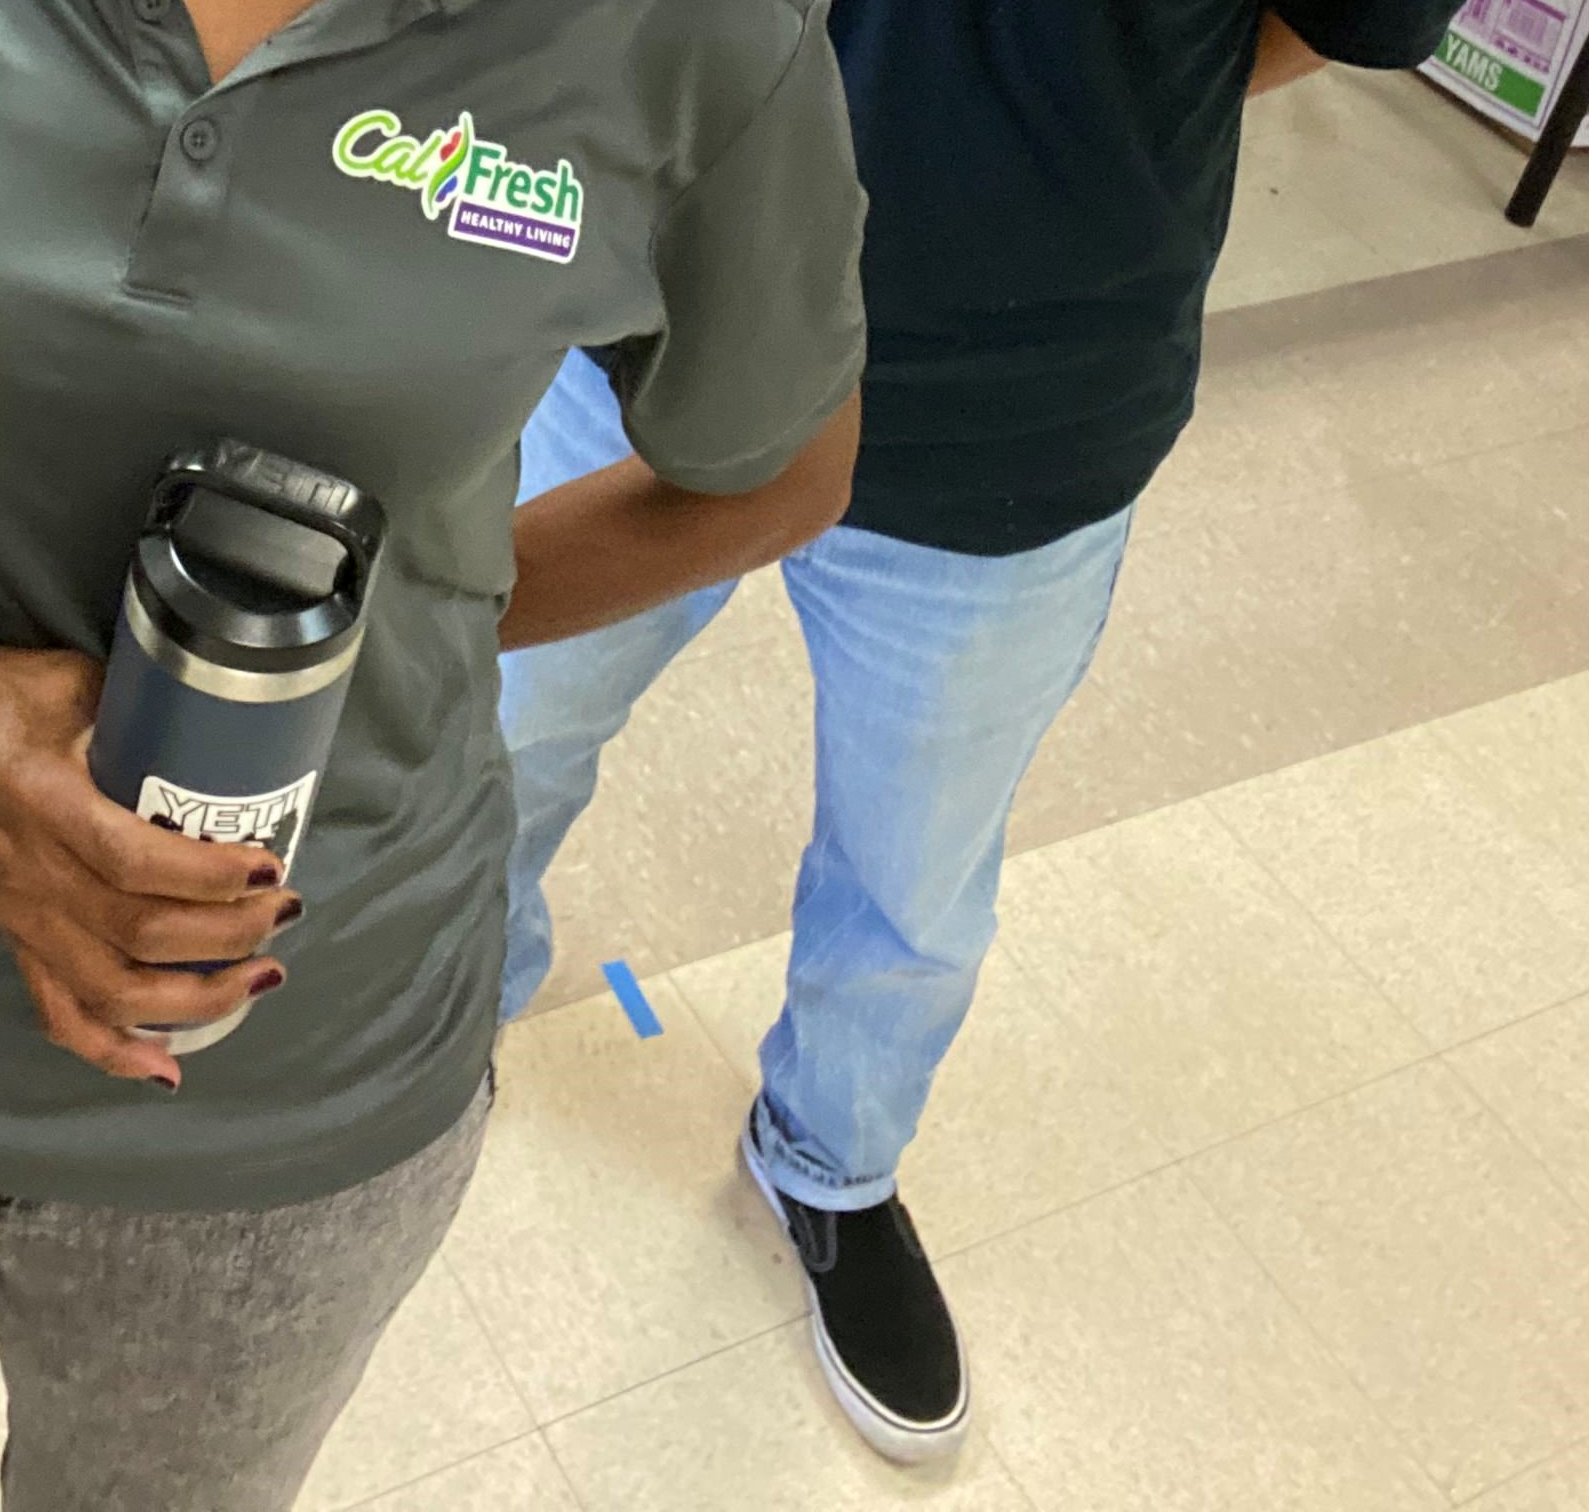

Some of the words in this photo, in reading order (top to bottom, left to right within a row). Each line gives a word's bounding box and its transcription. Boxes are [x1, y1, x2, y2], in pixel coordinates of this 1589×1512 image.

[1446, 33, 1502, 90] YAMS
[461, 210, 522, 238] HEALTHY
[526, 225, 571, 249] LIVING
[159, 784, 305, 834] YETI
